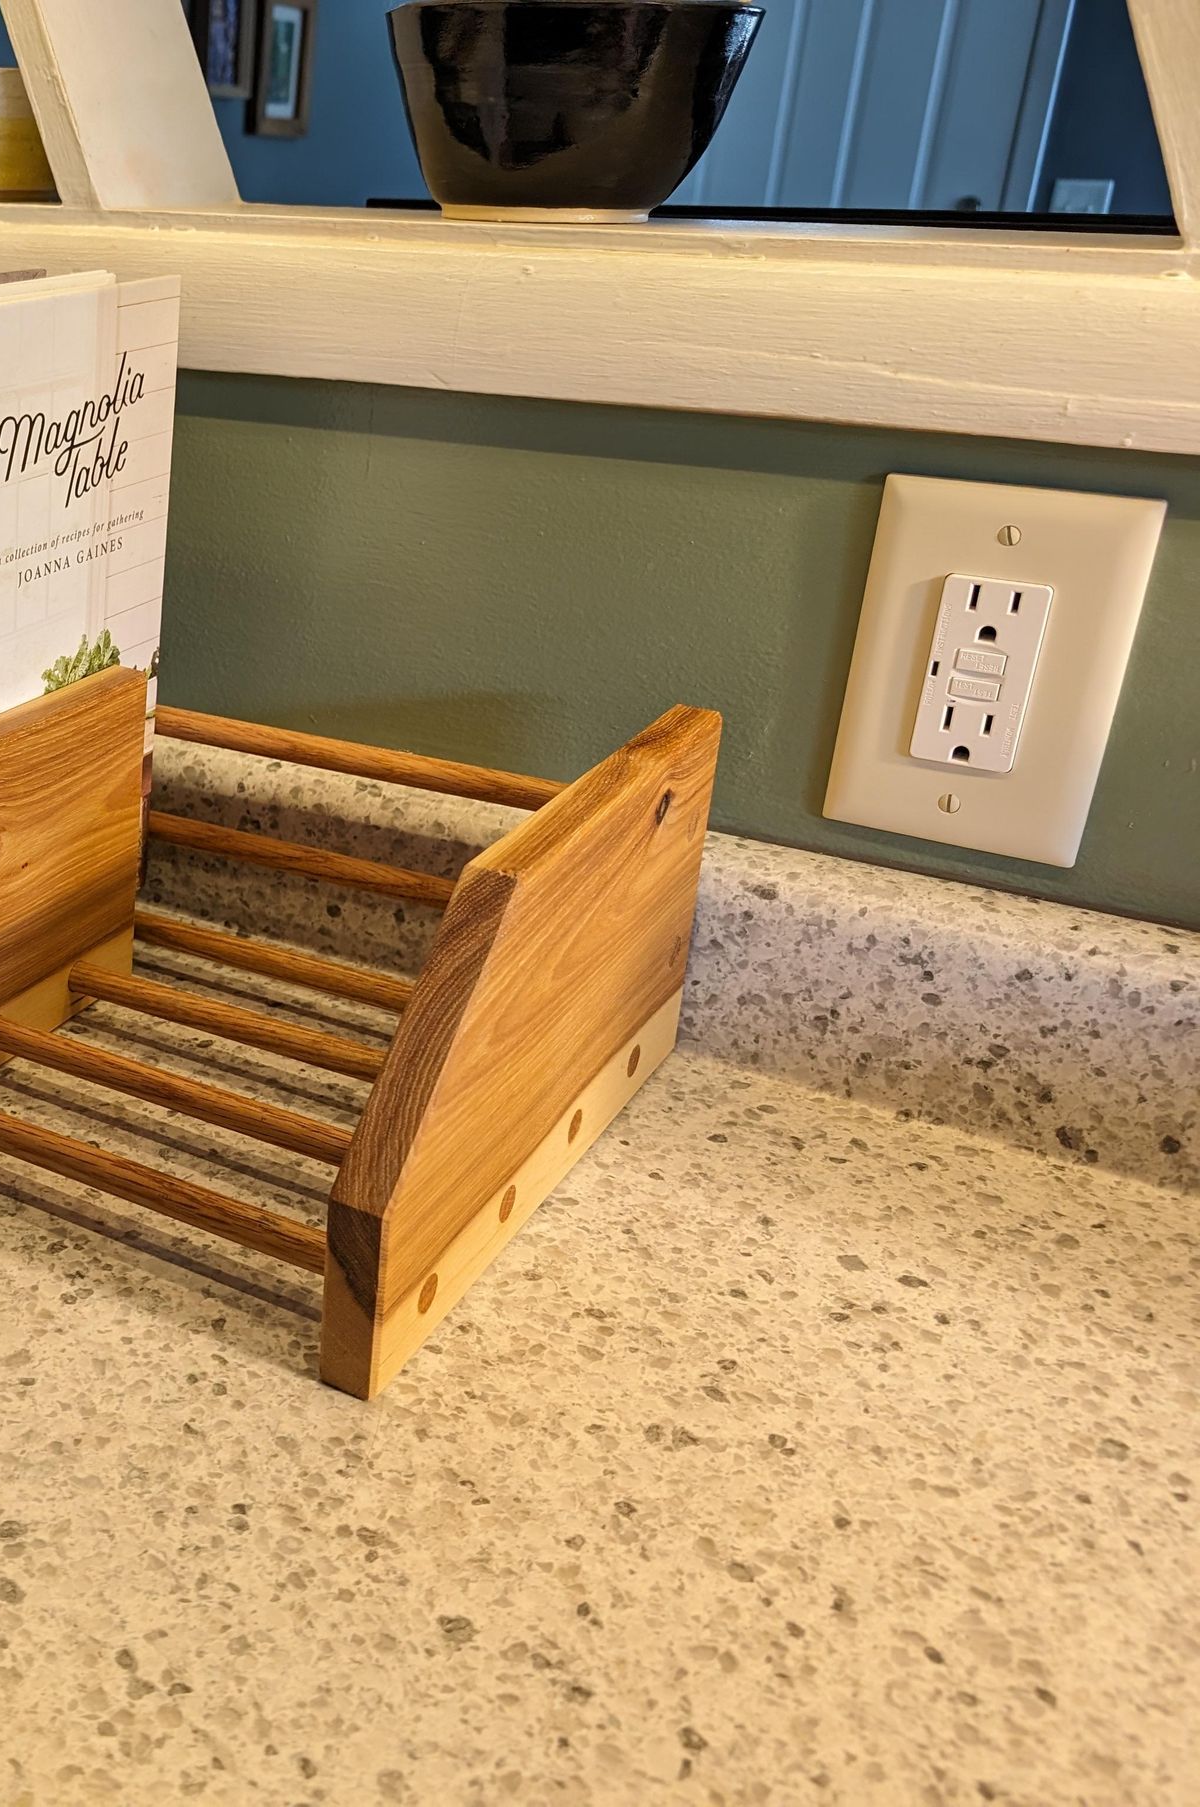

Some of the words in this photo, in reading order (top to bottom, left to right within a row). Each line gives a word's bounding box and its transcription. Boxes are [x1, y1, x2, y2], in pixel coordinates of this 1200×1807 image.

[65, 417, 129, 508] Table
[5, 538, 48, 564] collection
[50, 534, 60, 550] of
[62, 526, 91, 546] recipes
[92, 520, 104, 536] for
[107, 509, 144, 531] gathering
[18, 557, 71, 588] JOANNA
[76, 536, 124, 564] GAINES
[960, 652, 985, 662] RESET
[954, 681, 974, 690] TEST
